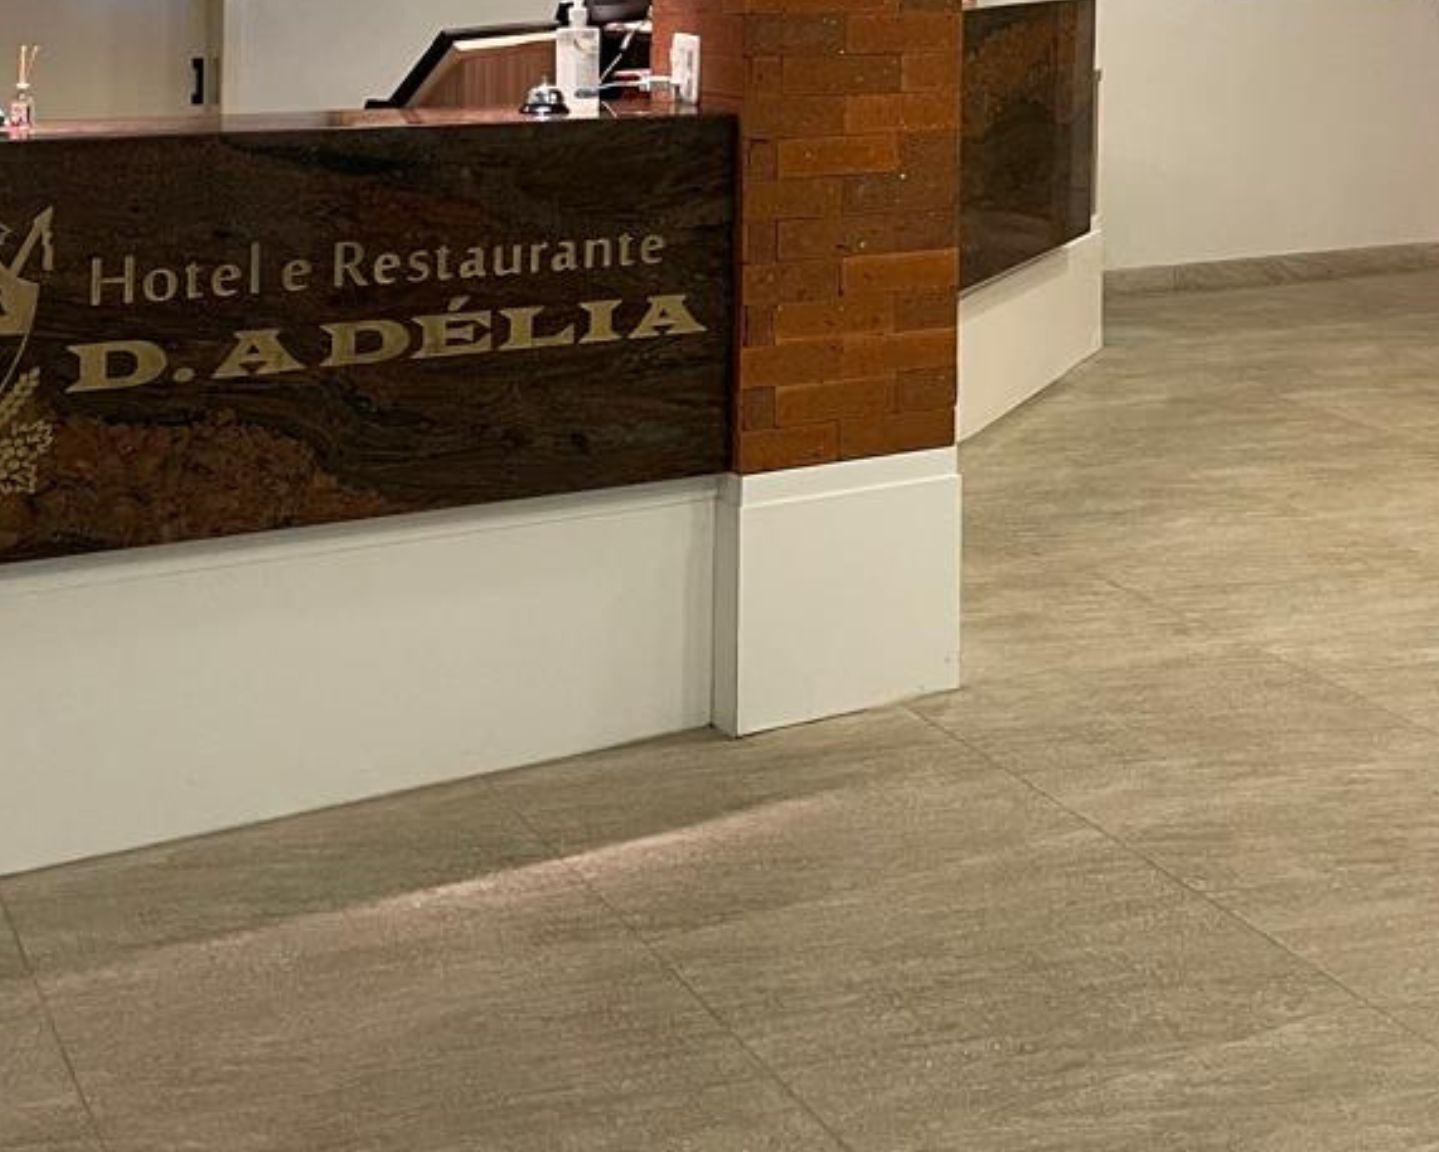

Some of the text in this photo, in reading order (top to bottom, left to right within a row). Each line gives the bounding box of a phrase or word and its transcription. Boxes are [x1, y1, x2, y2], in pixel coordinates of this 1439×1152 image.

[89, 232, 665, 306] Hotel e Restaurante
